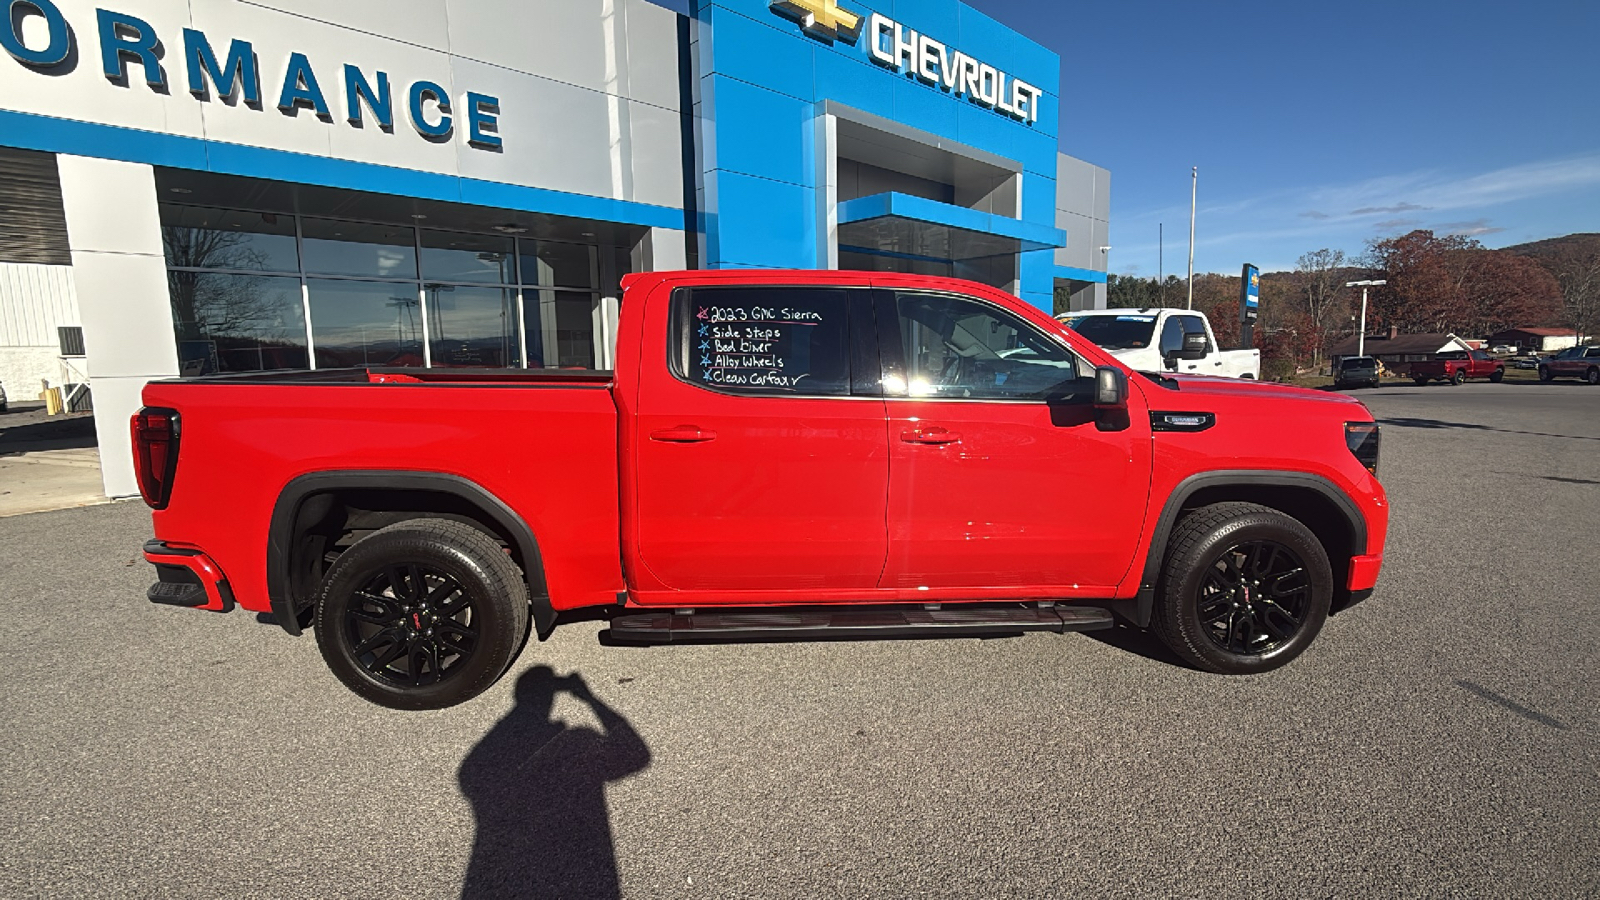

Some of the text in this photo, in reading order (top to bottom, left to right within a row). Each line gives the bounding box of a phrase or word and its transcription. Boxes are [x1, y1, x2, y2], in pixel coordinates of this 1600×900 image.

[868, 12, 1042, 123] CHEVROLET
[0, 0, 503, 153] ORMANCE
[711, 306, 823, 323] 2023 GMC Sierra
[712, 325, 781, 341] Side Steps
[715, 338, 736, 352] Bed
[714, 354, 784, 369] Alloy Wheels
[713, 369, 747, 384] Clean
